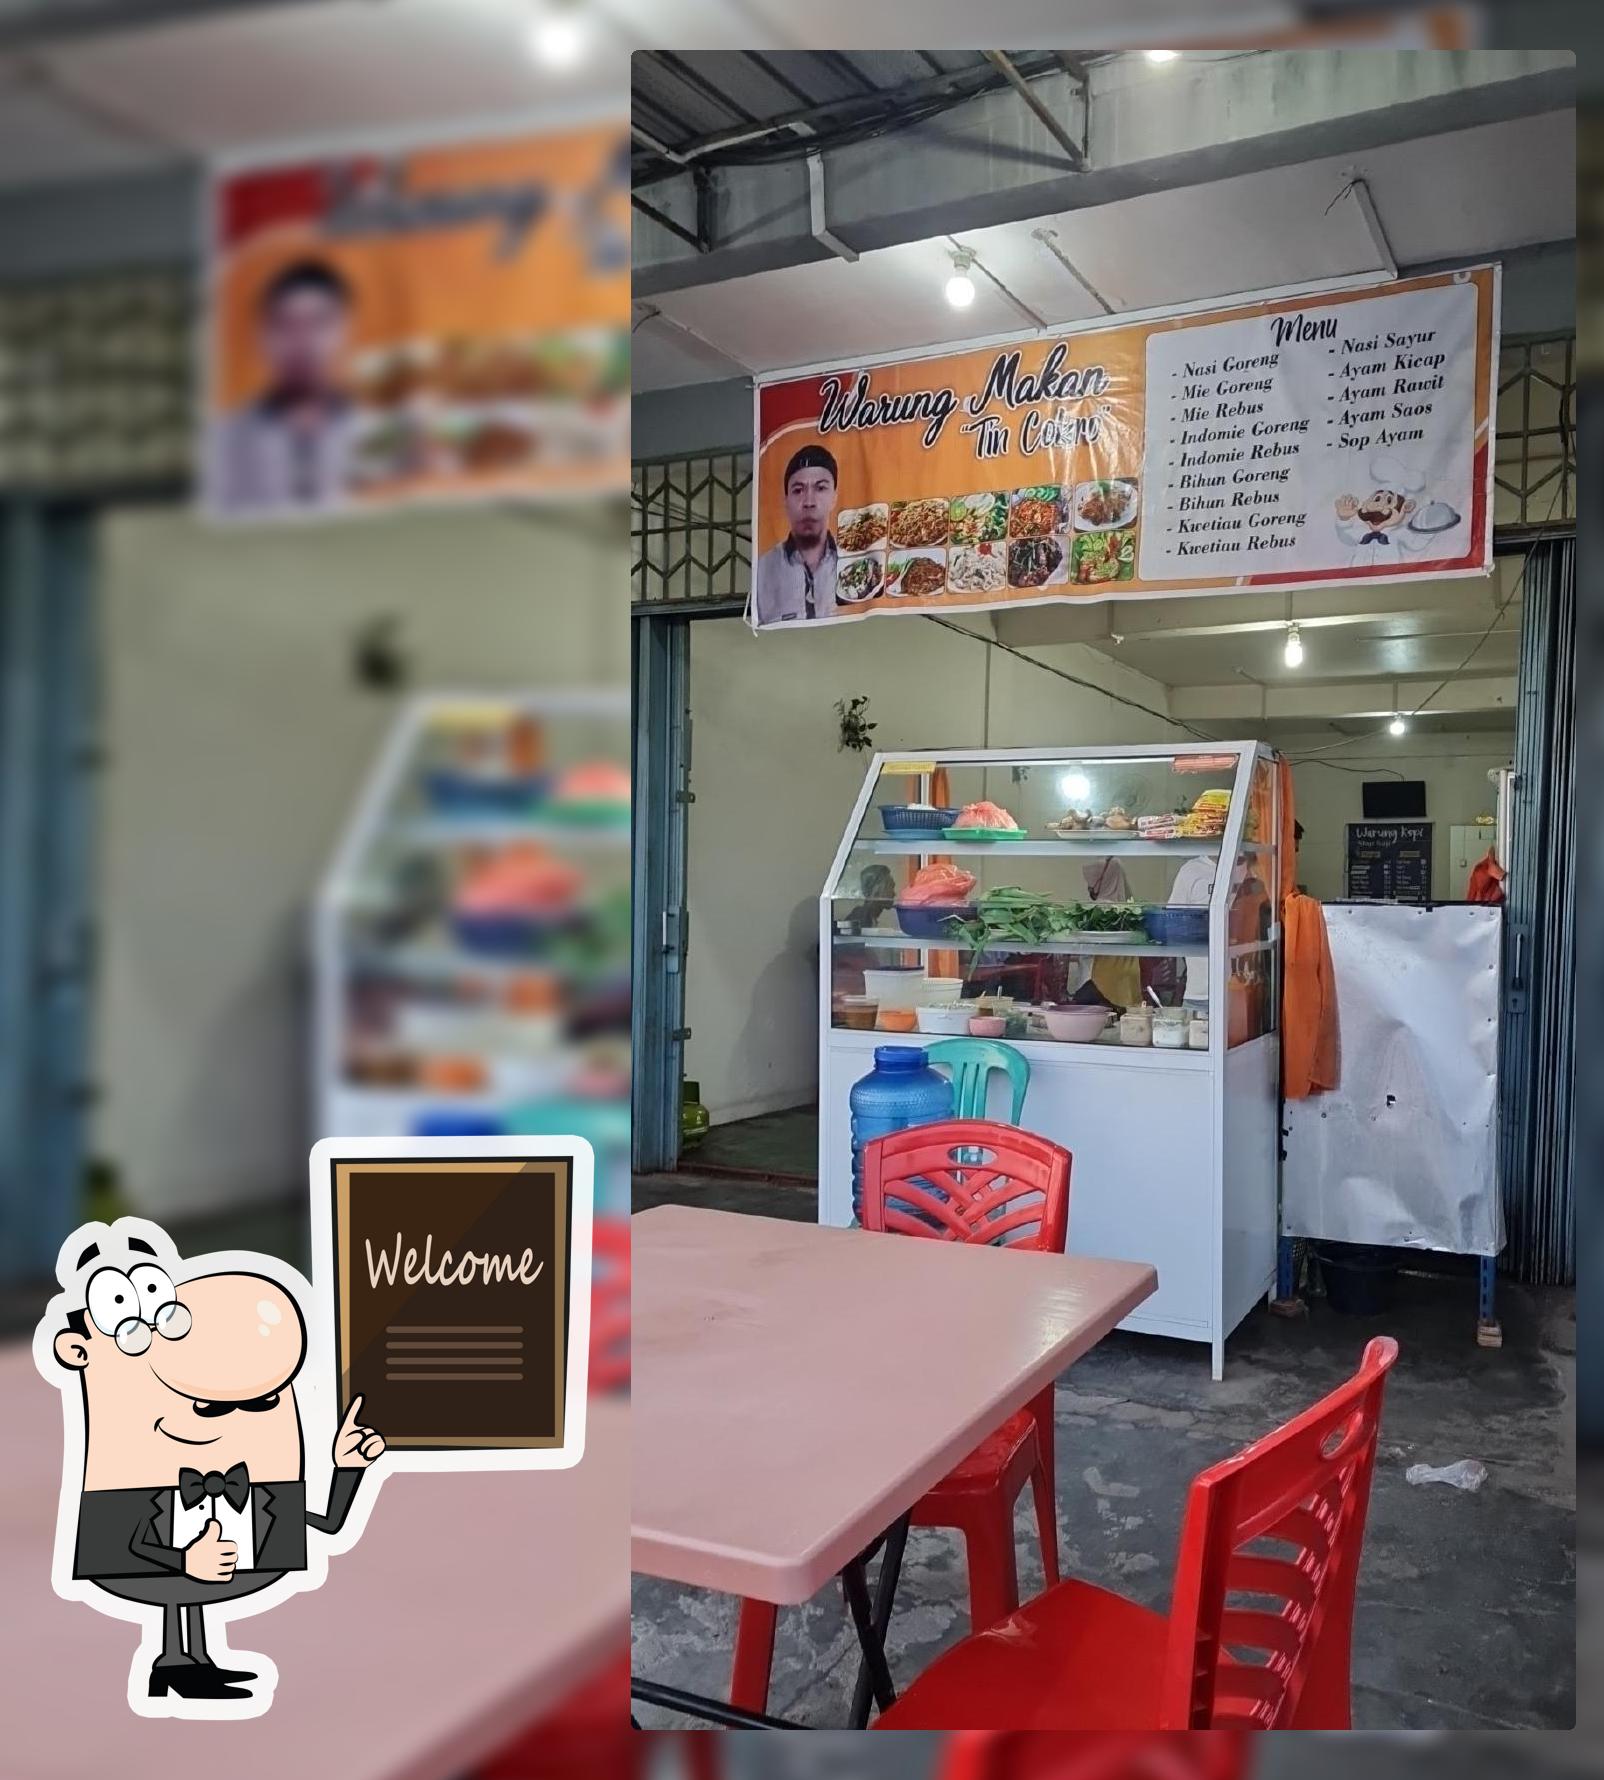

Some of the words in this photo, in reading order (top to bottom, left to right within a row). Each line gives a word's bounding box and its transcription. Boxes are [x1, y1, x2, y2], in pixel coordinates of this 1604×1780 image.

[1271, 314, 1338, 347] Menu
[1341, 336, 1378, 355] Nasi
[1384, 330, 1436, 350] Sayur
[1183, 361, 1217, 378] Nasi
[1223, 352, 1279, 374] Goreng
[1339, 361, 1387, 382] Ayam
[1394, 352, 1445, 371] Kicap
[818, 373, 958, 448] Warung
[968, 341, 1110, 417] Makan
[1182, 385, 1210, 401] Mie
[1217, 377, 1273, 398] Goreng
[1339, 385, 1386, 406] Ayam
[1393, 374, 1444, 392] Rawit
[1181, 407, 1209, 423] Mie
[1216, 402, 1264, 418] Rebus
[1338, 410, 1385, 428] Ayam
[1392, 401, 1433, 418] Saos
[1181, 425, 1245, 445] Indomie
[1252, 417, 1310, 438] Goreng
[1338, 433, 1370, 451] Sop
[1376, 428, 1424, 445] Ayam
[1180, 449, 1245, 468] Indomie
[1251, 442, 1300, 459] Rebus
[1180, 471, 1226, 490] Bihun
[1232, 466, 1291, 487] Goreng
[1179, 494, 1225, 512] Bihun
[1231, 491, 1280, 507] Rebus
[1178, 518, 1242, 534] Kwetiau
[1248, 512, 1307, 530] Goreng
[1177, 540, 1240, 556] Kwetiau
[1248, 536, 1296, 551] Rebus
[1356, 827, 1398, 844] Warung
